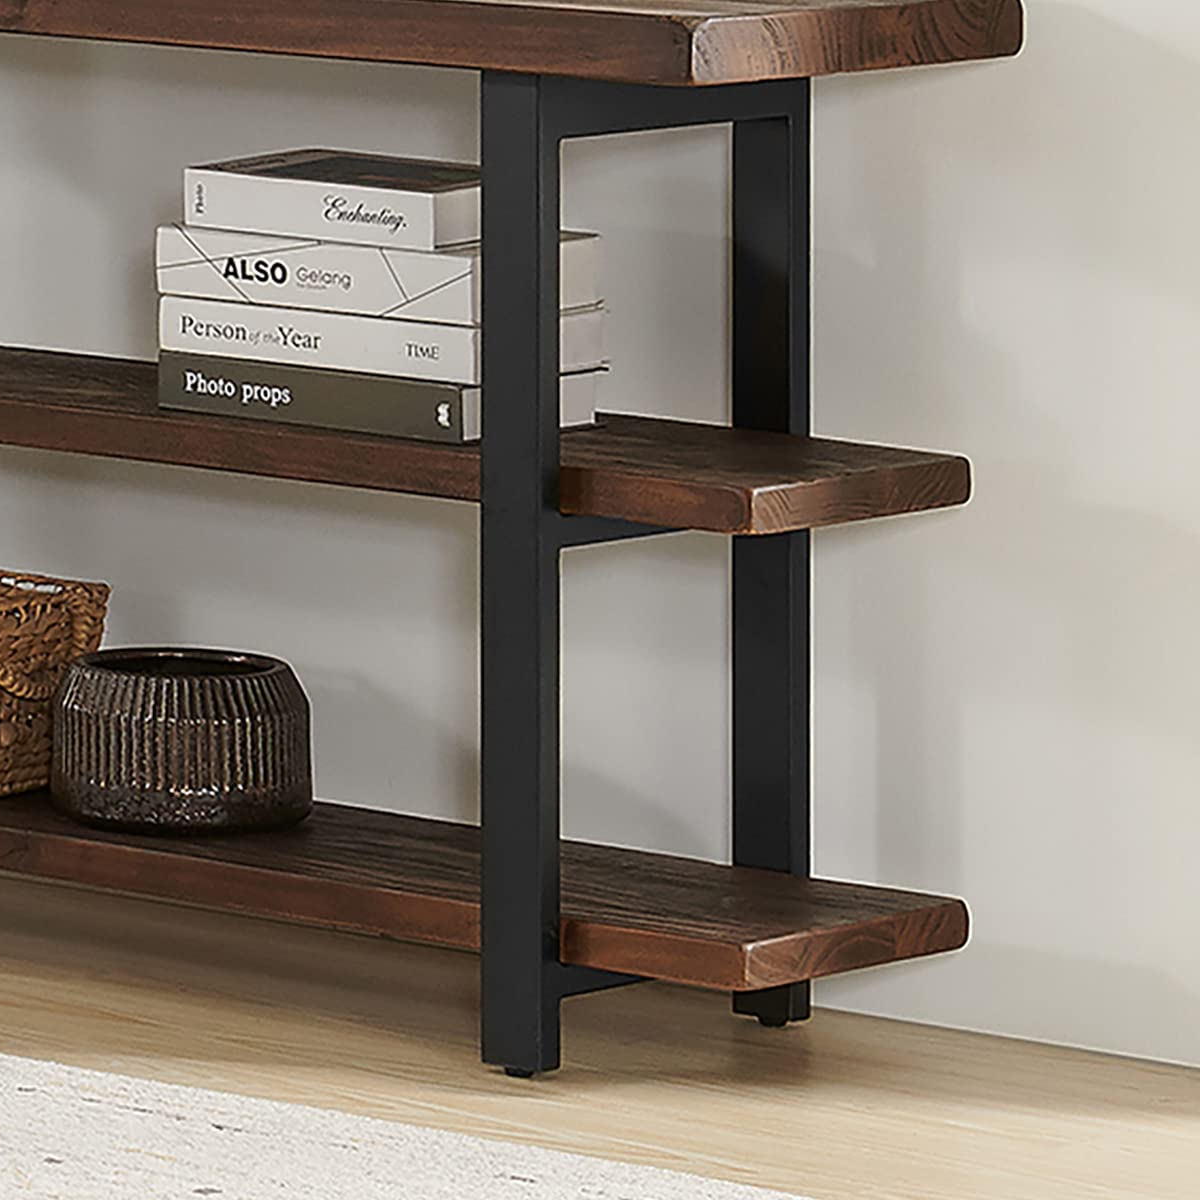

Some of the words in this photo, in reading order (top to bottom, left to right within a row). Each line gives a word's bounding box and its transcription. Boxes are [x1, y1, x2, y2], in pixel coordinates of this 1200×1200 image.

[222, 257, 288, 284] ALSO
[181, 315, 246, 341] Person
[278, 325, 322, 349] Year
[406, 343, 440, 360] TIME
[185, 371, 236, 397] Photo
[241, 384, 291, 407] props
